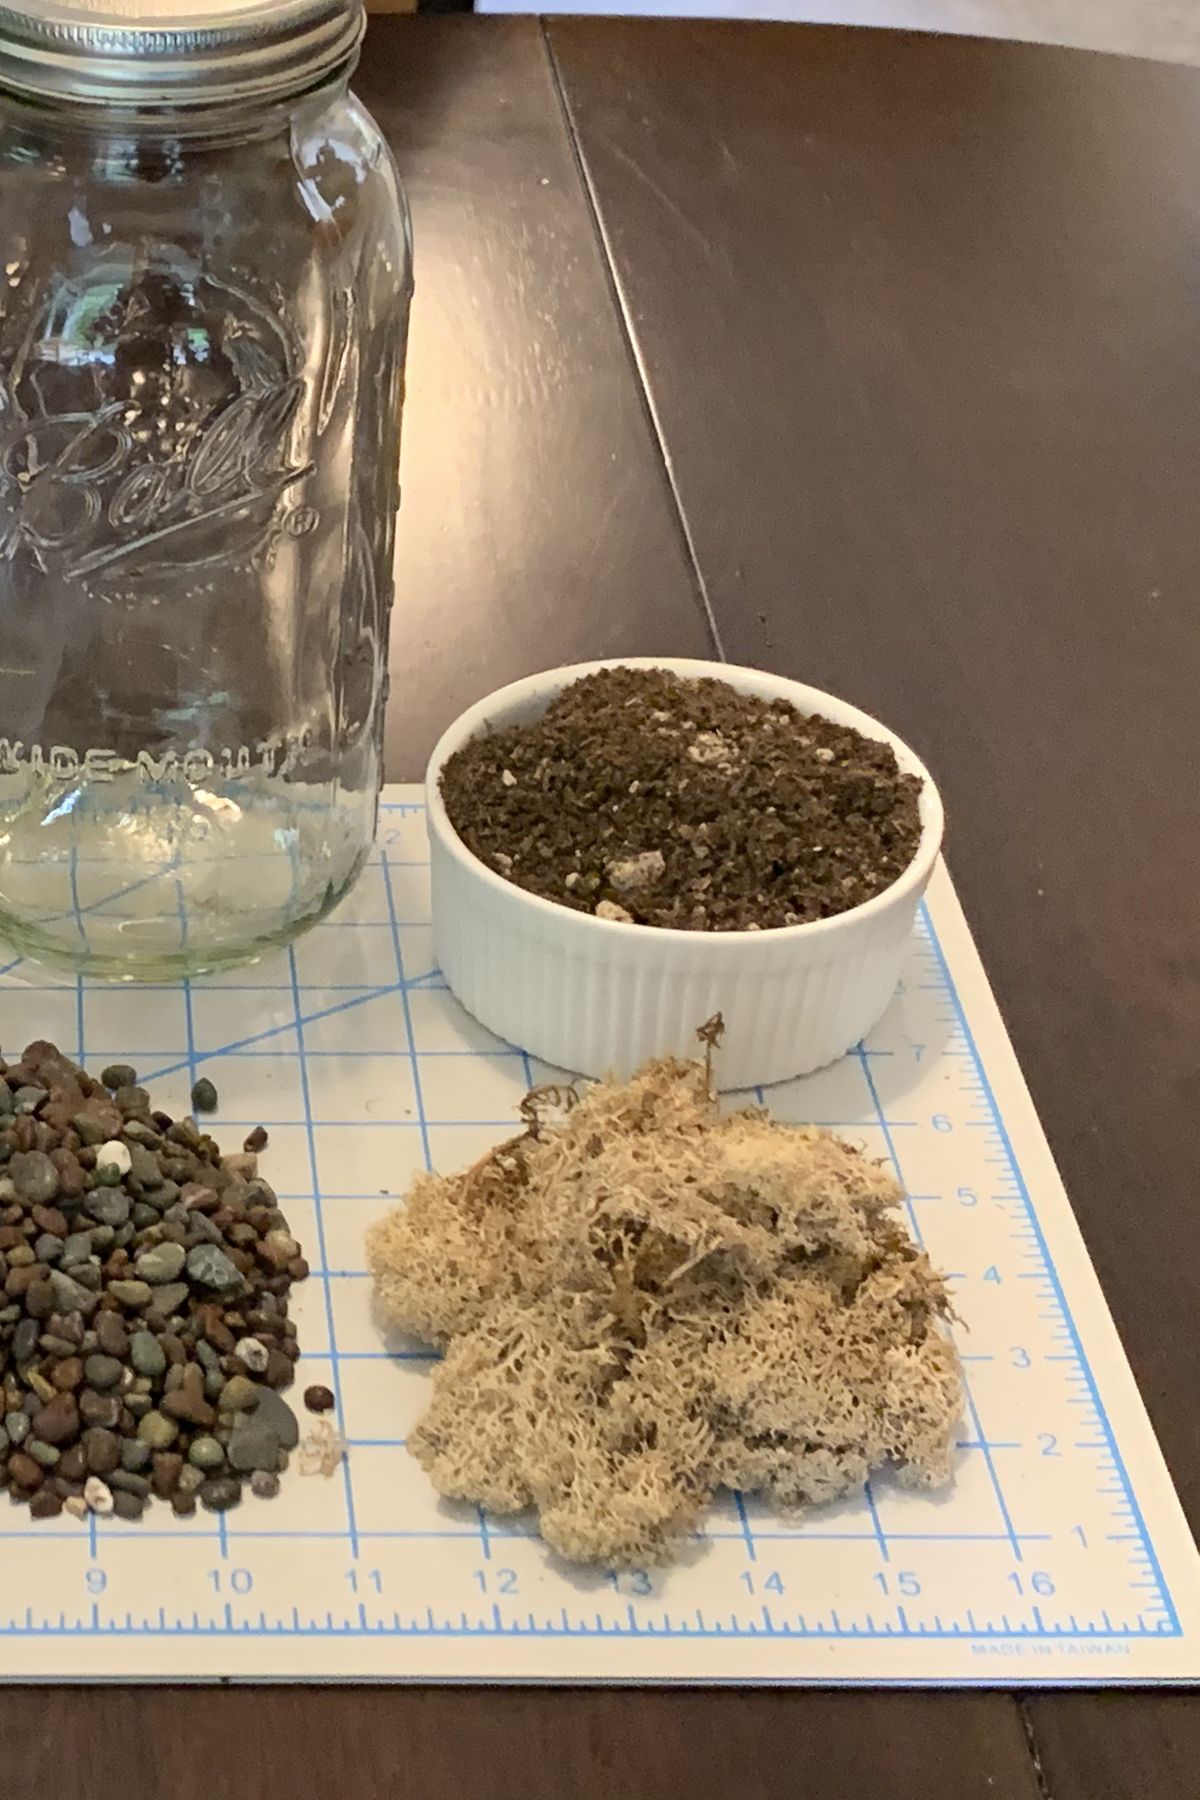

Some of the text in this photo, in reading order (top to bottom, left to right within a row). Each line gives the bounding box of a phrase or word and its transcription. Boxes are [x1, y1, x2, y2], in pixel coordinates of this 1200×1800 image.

[909, 1044, 926, 1062] 7
[931, 1114, 953, 1132] 6
[957, 1187, 978, 1206] 5
[982, 1266, 1003, 1285] 4
[1010, 1347, 1031, 1368] 3
[1038, 1434, 1062, 1456] 2
[1071, 1526, 1089, 1548] 1
[85, 1569, 108, 1594] 9
[207, 1569, 253, 1594] 10
[344, 1569, 383, 1594] 11
[473, 1569, 519, 1594] 12
[741, 1570, 786, 1595] 14
[873, 1571, 922, 1596] 15
[1007, 1571, 1056, 1596] 16
[970, 1643, 1131, 1656] MADE IN TAIWAN
